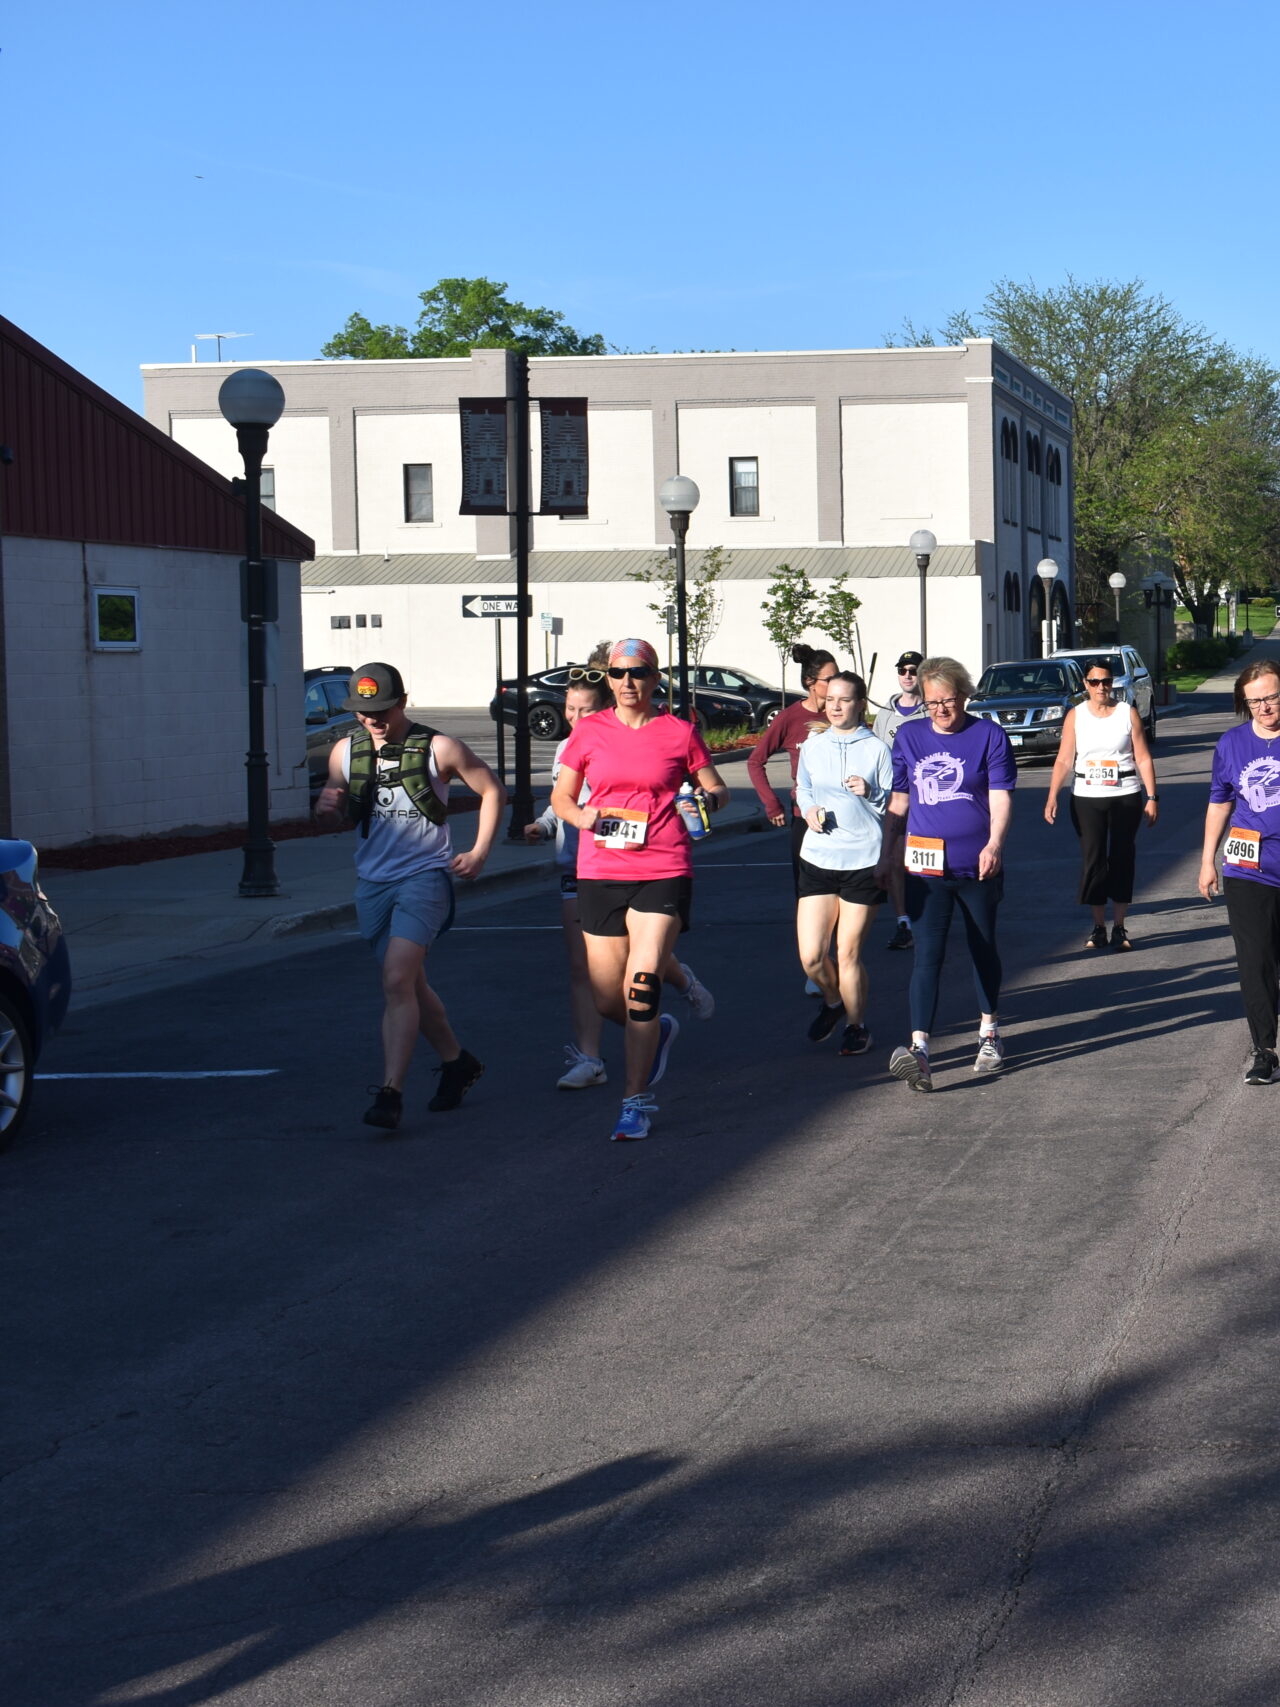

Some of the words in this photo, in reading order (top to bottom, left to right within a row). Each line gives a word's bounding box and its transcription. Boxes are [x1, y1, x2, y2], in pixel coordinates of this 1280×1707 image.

[482, 602, 502, 611] ONE
[505, 602, 518, 611] WA
[600, 820, 638, 839] 5941
[1227, 840, 1255, 858] 5896
[912, 850, 935, 866] 3111
